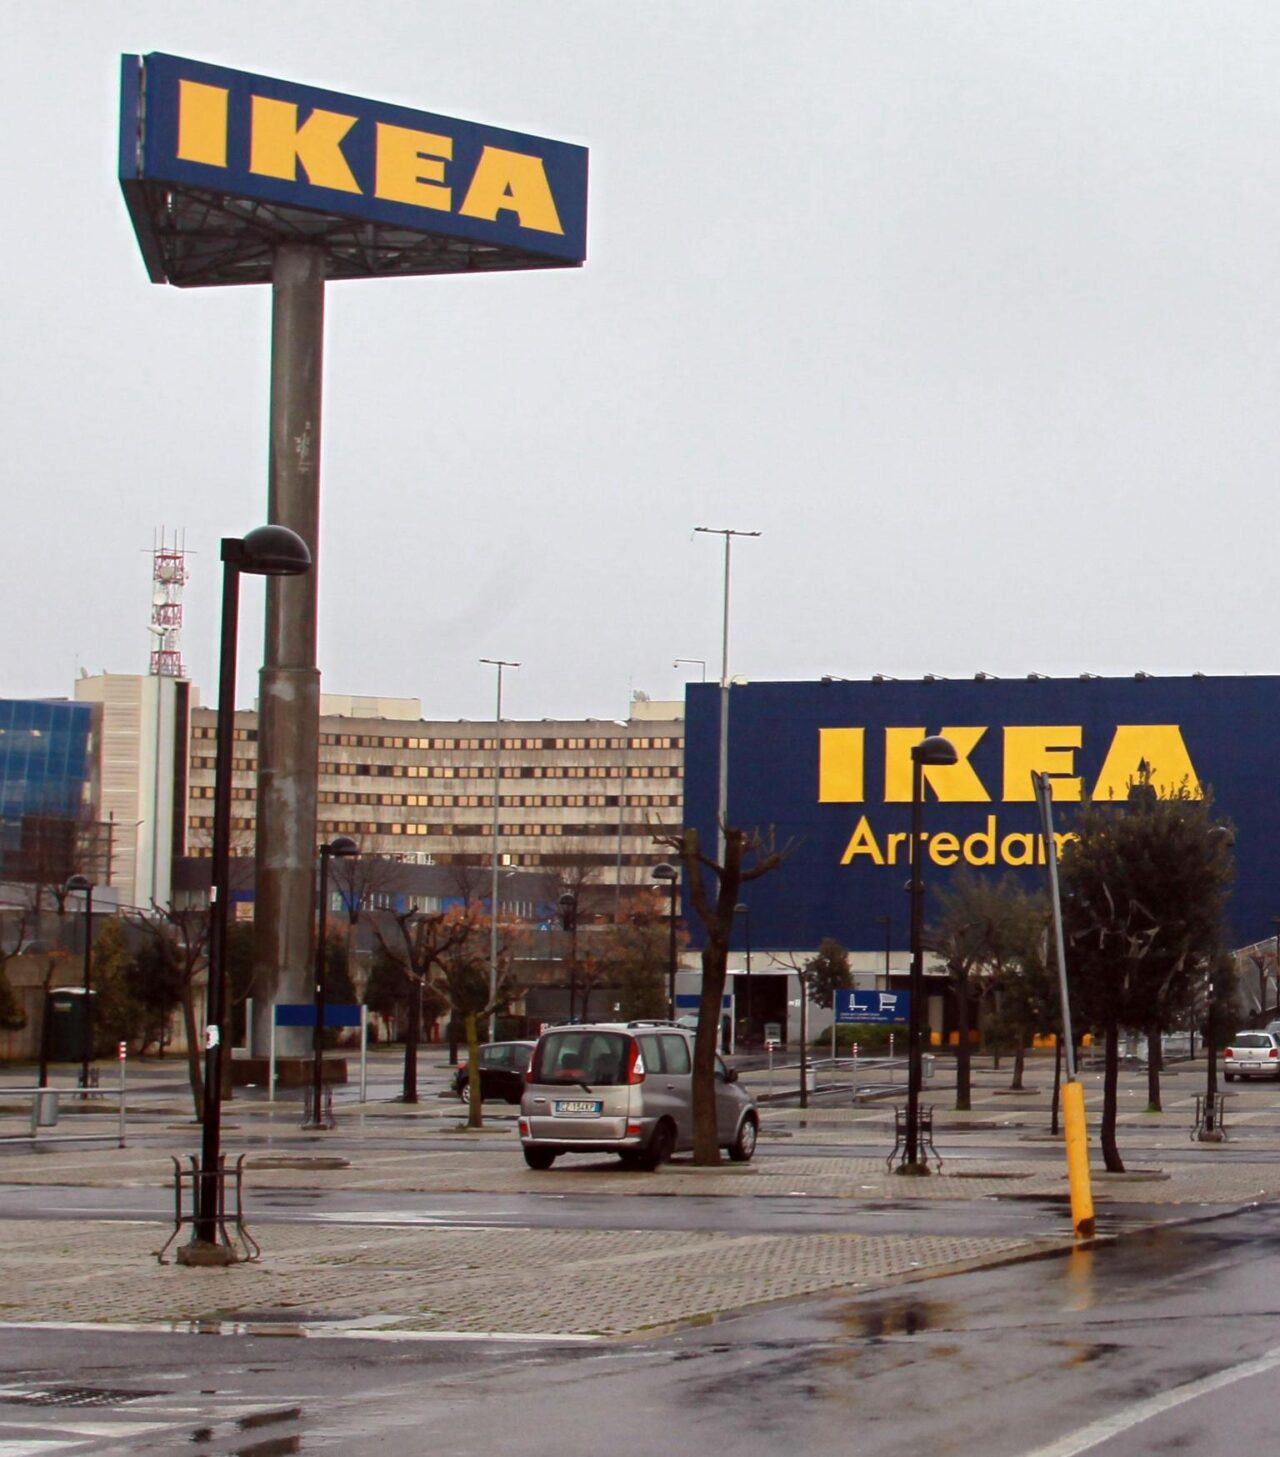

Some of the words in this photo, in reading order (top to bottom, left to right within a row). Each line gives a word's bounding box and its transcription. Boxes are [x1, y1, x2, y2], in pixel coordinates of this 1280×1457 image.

[177, 79, 564, 235] IKEA
[818, 724, 1202, 803] IKEA
[840, 815, 1081, 867] Arredam
